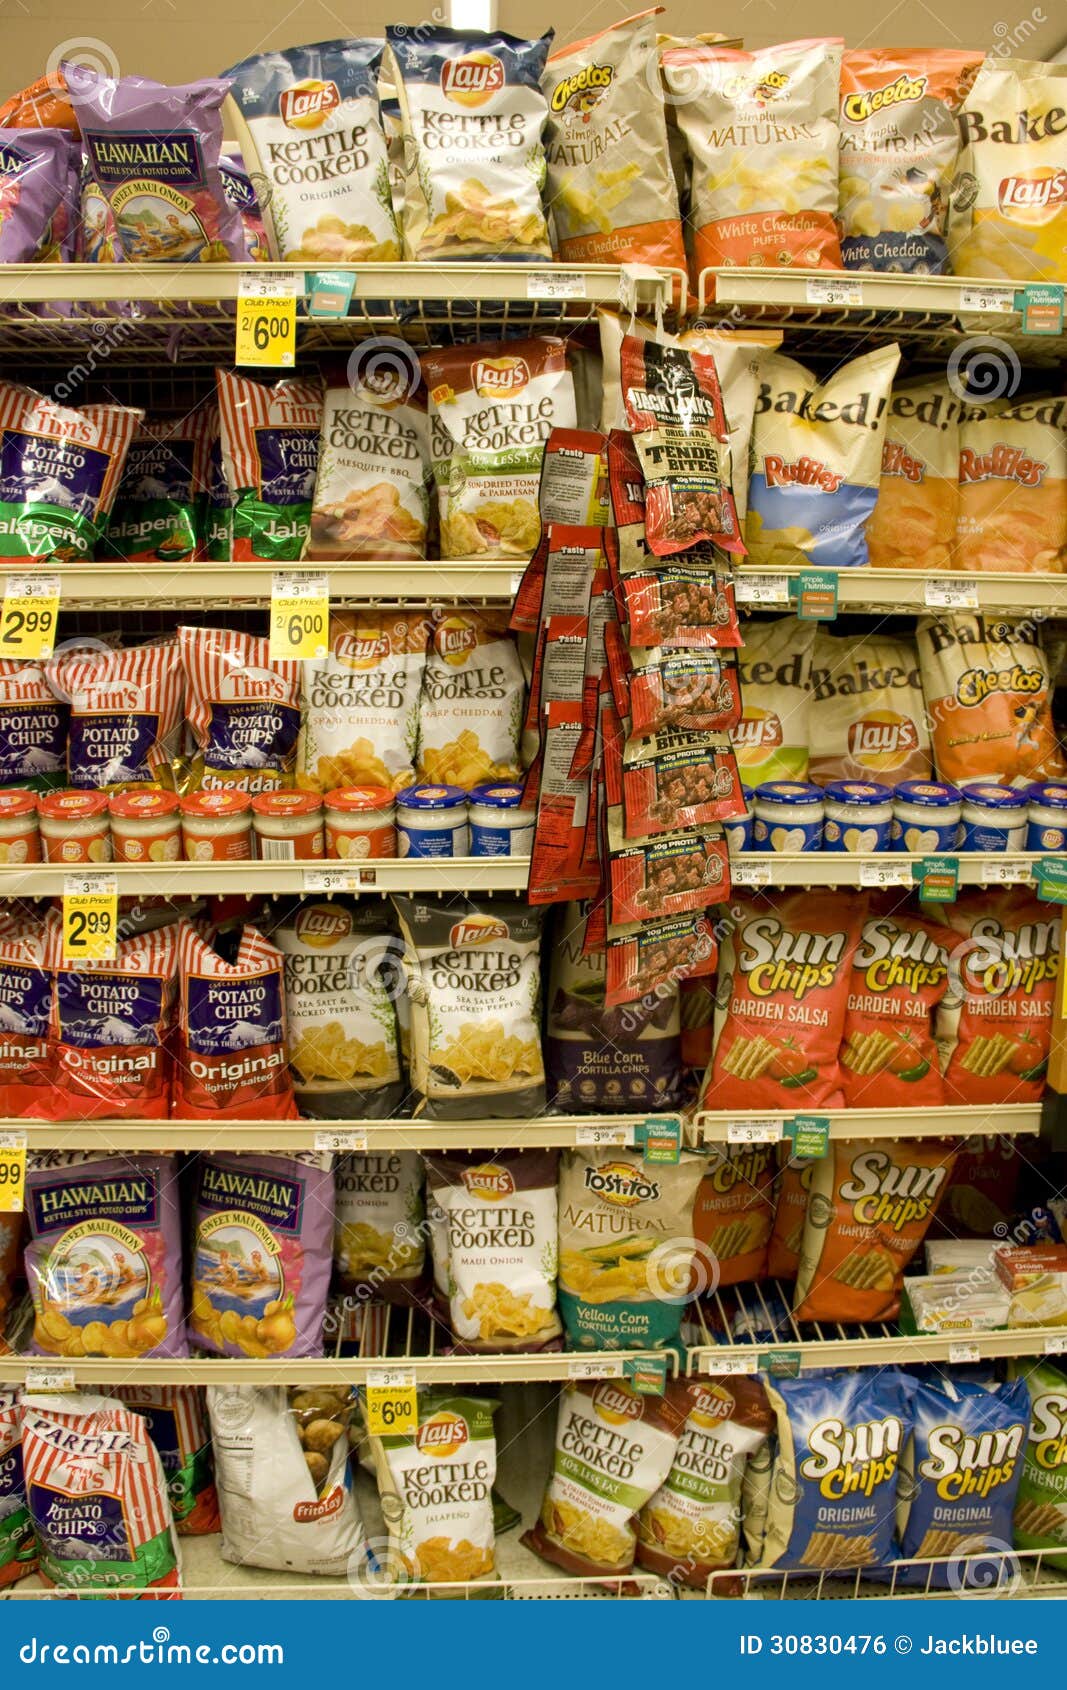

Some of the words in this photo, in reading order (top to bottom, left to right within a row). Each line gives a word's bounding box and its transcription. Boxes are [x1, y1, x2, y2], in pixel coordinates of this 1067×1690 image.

[551, 64, 614, 113] Cheetos
[844, 76, 928, 122] Cheetos
[421, 109, 526, 134] KETTLE
[266, 125, 367, 164] KETTLE
[422, 129, 525, 150] COOKED
[707, 122, 821, 147] NATURAL
[93, 141, 189, 165] HAWAIIAN
[273, 149, 368, 185] COOKED
[112, 184, 134, 211] SWEET
[134, 180, 158, 196] MAUI
[158, 186, 190, 210] ONION
[300, 186, 353, 201] ORIGINAL
[717, 223, 757, 240] White
[762, 216, 818, 232] Cheddar
[753, 235, 786, 247] PUFFS
[874, 242, 929, 258] Cheddar
[245, 299, 265, 307] Club
[462, 397, 554, 435] KETTLE
[329, 428, 420, 460] COOKED
[462, 420, 552, 449] COOKED
[24, 440, 85, 467] POTATO
[29, 459, 76, 480] CHIPS
[336, 458, 388, 474] MESQUITE
[390, 467, 411, 479] BBQ
[668, 458, 719, 474] BITES
[764, 455, 845, 493] Ruffles
[959, 443, 1047, 488] Ruffles
[479, 489, 487, 497] &
[489, 488, 535, 497] PARMESAN
[0, 514, 88, 551] alapeño
[312, 670, 407, 690] KETTLE
[957, 665, 1046, 708] Cheetos
[311, 689, 404, 709] COOKED
[1, 714, 59, 731] POTATO
[228, 714, 283, 731] POTATO
[452, 708, 504, 718] CHEDDAR
[8, 731, 54, 746] CHIPS
[81, 727, 140, 743] POTATO
[656, 734, 711, 750] BITES
[87, 743, 132, 759] CHIPS
[201, 775, 283, 792] Cheddar
[69, 896, 89, 905] Club
[89, 896, 112, 905] Price!
[740, 917, 846, 973] Sun
[852, 919, 949, 970] Sun
[966, 918, 1061, 973] Sun
[430, 950, 522, 971] KETTLE
[432, 969, 521, 992] COOKED
[747, 960, 838, 999] Chips
[865, 957, 947, 994] Chips
[983, 954, 1060, 995] Chips
[81, 984, 139, 1000] POTATO
[208, 987, 266, 1005] POTATO
[297, 1000, 314, 1009] SEA
[316, 999, 338, 1009] SALT
[340, 998, 347, 1007] &
[87, 1000, 133, 1016] CHIPS
[214, 1003, 261, 1020] CHIPS
[732, 998, 785, 1021] GARDEN
[788, 1005, 829, 1027] SALSA
[847, 994, 901, 1015] GARDEN
[904, 1001, 929, 1018] SAL
[967, 999, 1017, 1016] GARDEN
[1019, 999, 1052, 1017] SALS
[64, 1051, 157, 1073] Original
[190, 1048, 285, 1081] Original
[583, 1050, 610, 1065] Blue
[613, 1051, 645, 1064] Corn
[577, 1065, 622, 1075] TORTILLA
[622, 1065, 650, 1074] CHIPS
[205, 1079, 238, 1093] lightly
[240, 1071, 274, 1086] salted
[203, 1167, 294, 1207] HAWAIIAN
[584, 1167, 661, 1200] Tostitos
[839, 1151, 948, 1200] Sun
[40, 1182, 147, 1213] HAWAIIAN
[43, 1211, 73, 1224] KETTLE
[74, 1209, 97, 1219] STYLE
[98, 1206, 125, 1216] POTATO
[125, 1204, 148, 1214] CHIPS
[449, 1208, 535, 1231] KETTLE
[563, 1204, 675, 1234] NATURAL
[853, 1193, 933, 1232] Chips
[201, 1213, 232, 1237] SWEET
[232, 1212, 255, 1228] MAUI
[252, 1218, 279, 1252] ONION
[451, 1228, 535, 1249] COOKED
[461, 1258, 487, 1266] MAUI
[489, 1256, 524, 1265] ONION
[576, 1305, 616, 1323] Yellow
[618, 1310, 650, 1325] Corn
[577, 1319, 620, 1333] TORTILLA
[620, 1324, 649, 1335] CHIPS
[565, 1411, 643, 1462] KETTLE
[801, 1416, 904, 1480] Sun
[561, 1433, 633, 1480] COOKED
[919, 1423, 1026, 1480] Sun
[401, 1460, 488, 1490] KETTLE
[579, 1466, 601, 1485] LESS
[601, 1478, 620, 1494] FAT
[819, 1453, 898, 1500] Chips
[936, 1459, 1017, 1501] Chips
[405, 1482, 487, 1508] COOKED
[47, 1502, 102, 1521] POTATO
[817, 1505, 878, 1522] ORIGINAL
[933, 1506, 993, 1522] ORIGINAL
[47, 1520, 97, 1536] CHIPS
